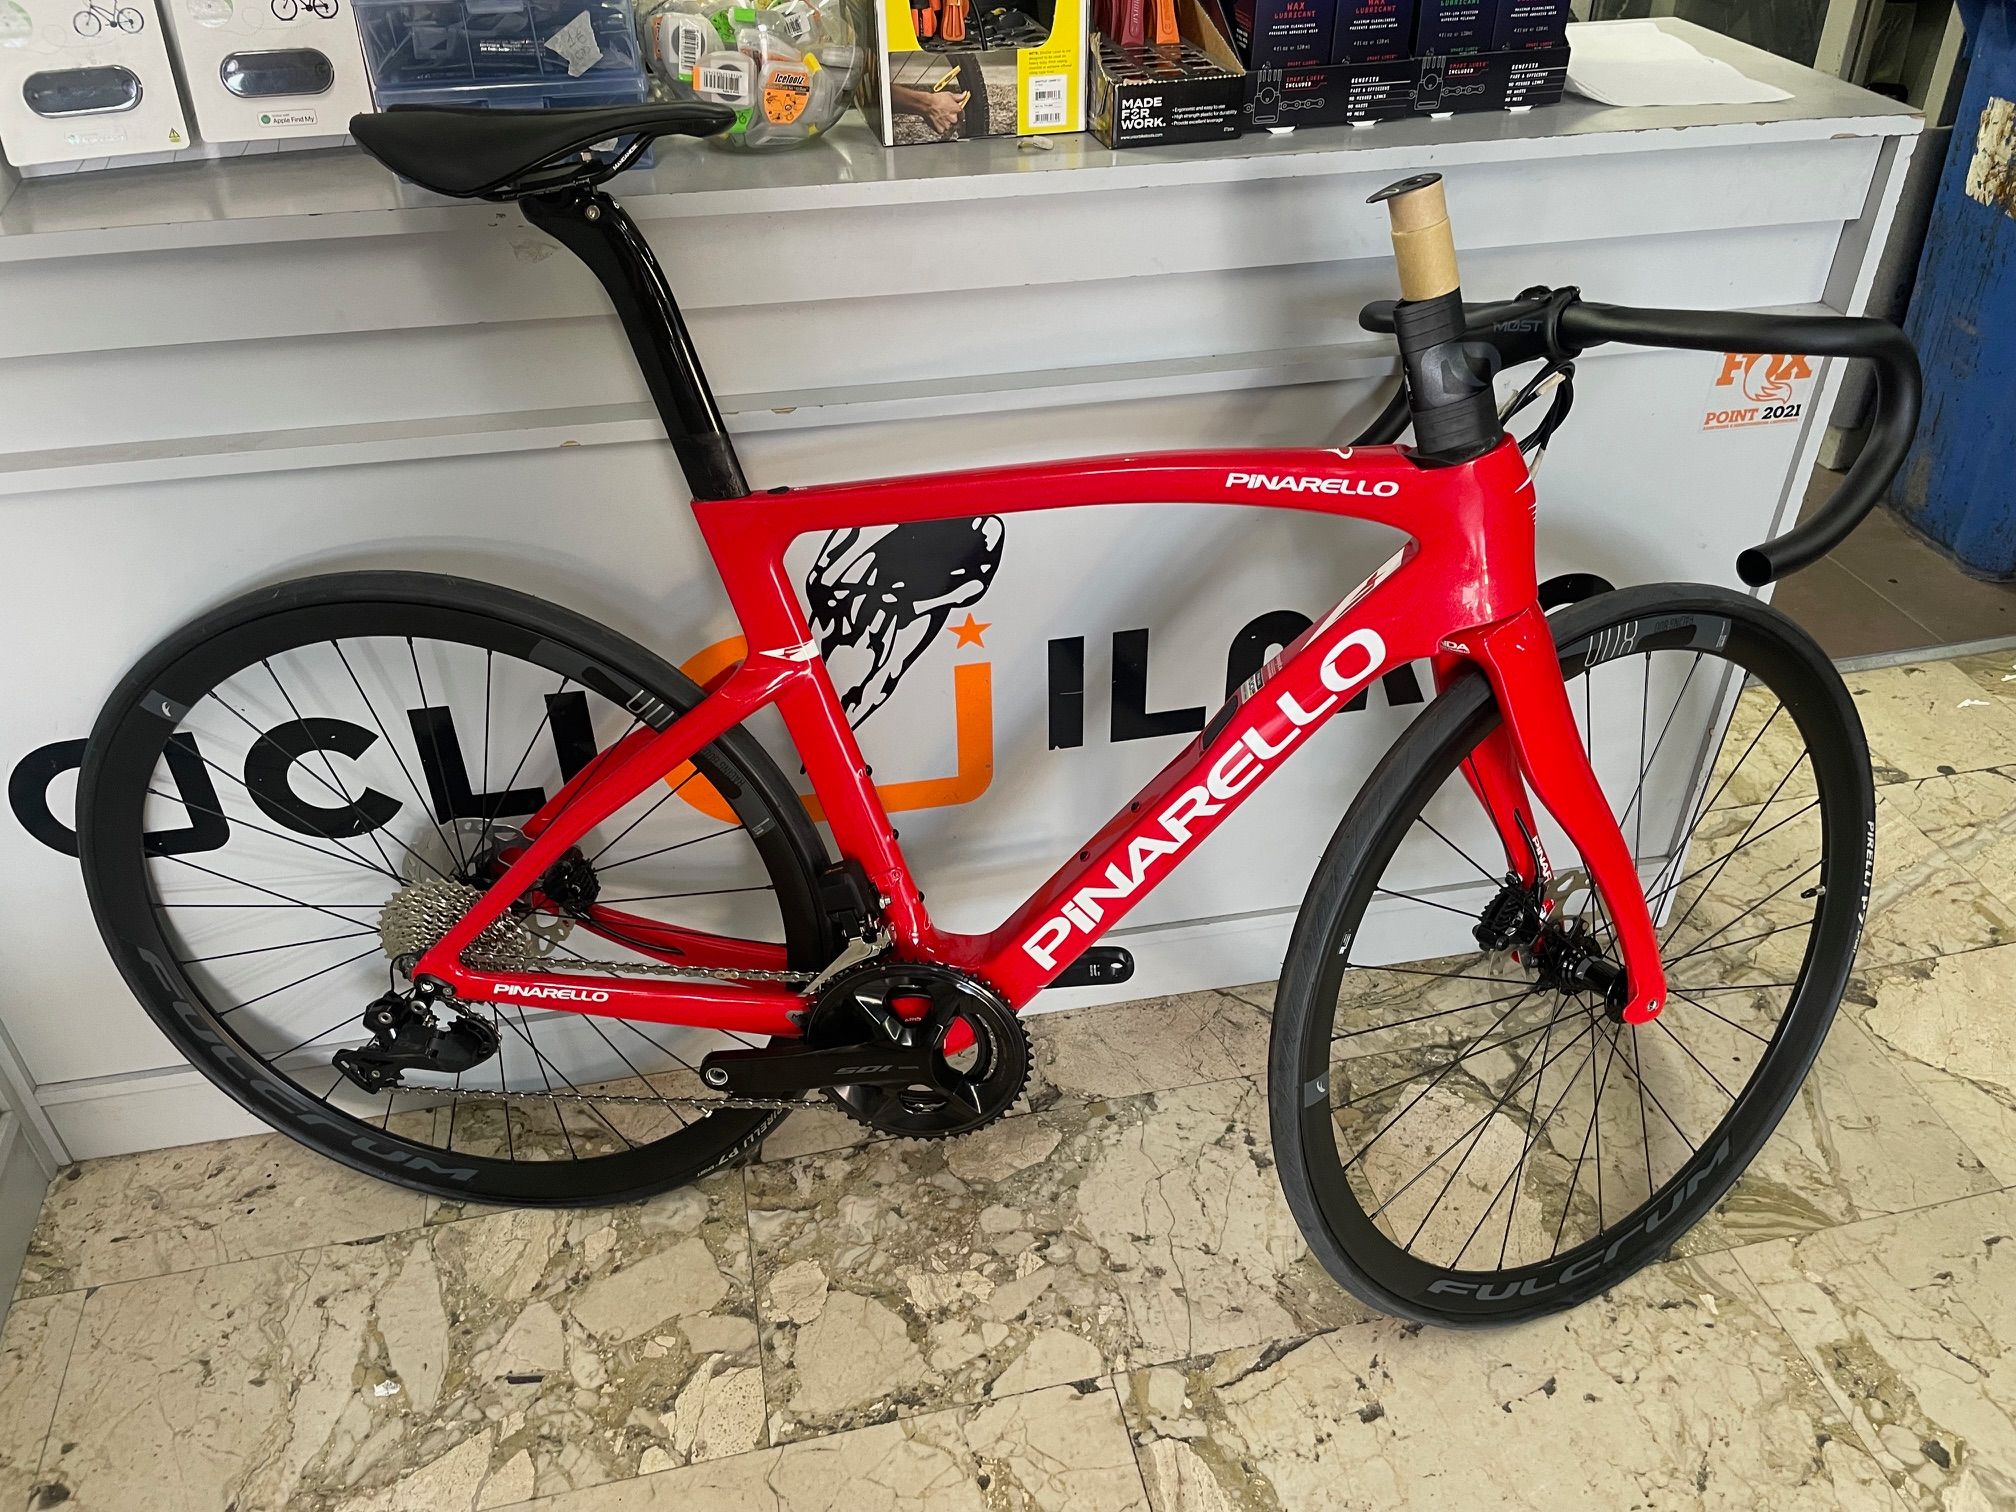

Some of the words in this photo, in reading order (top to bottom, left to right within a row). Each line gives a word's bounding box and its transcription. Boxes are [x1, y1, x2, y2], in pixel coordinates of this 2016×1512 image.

[1287, 2, 1305, 10] WAX
[1355, 5, 1397, 14] LUBRICANT
[1275, 10, 1316, 19] LUBRICANT
[1511, 62, 1539, 70] BENEFITS
[774, 72, 805, 86] IceToolz
[1351, 76, 1379, 84] BENEFITS
[1121, 96, 1163, 109] MADE
[272, 117, 290, 125] Apple
[304, 115, 315, 124] My
[1121, 107, 1150, 120] FOR
[1120, 117, 1167, 130] WORK.
[1703, 407, 1760, 426] POINT
[1760, 403, 1802, 420] 2021
[1225, 471, 1400, 498] PINARELLO
[1021, 627, 1388, 972] PINARELLO
[1862, 820, 1875, 888] PIRELLI
[492, 982, 610, 1005] PINARELLO
[138, 947, 480, 1182] FULCRUM
[1427, 1135, 1730, 1301] FULCRUM
